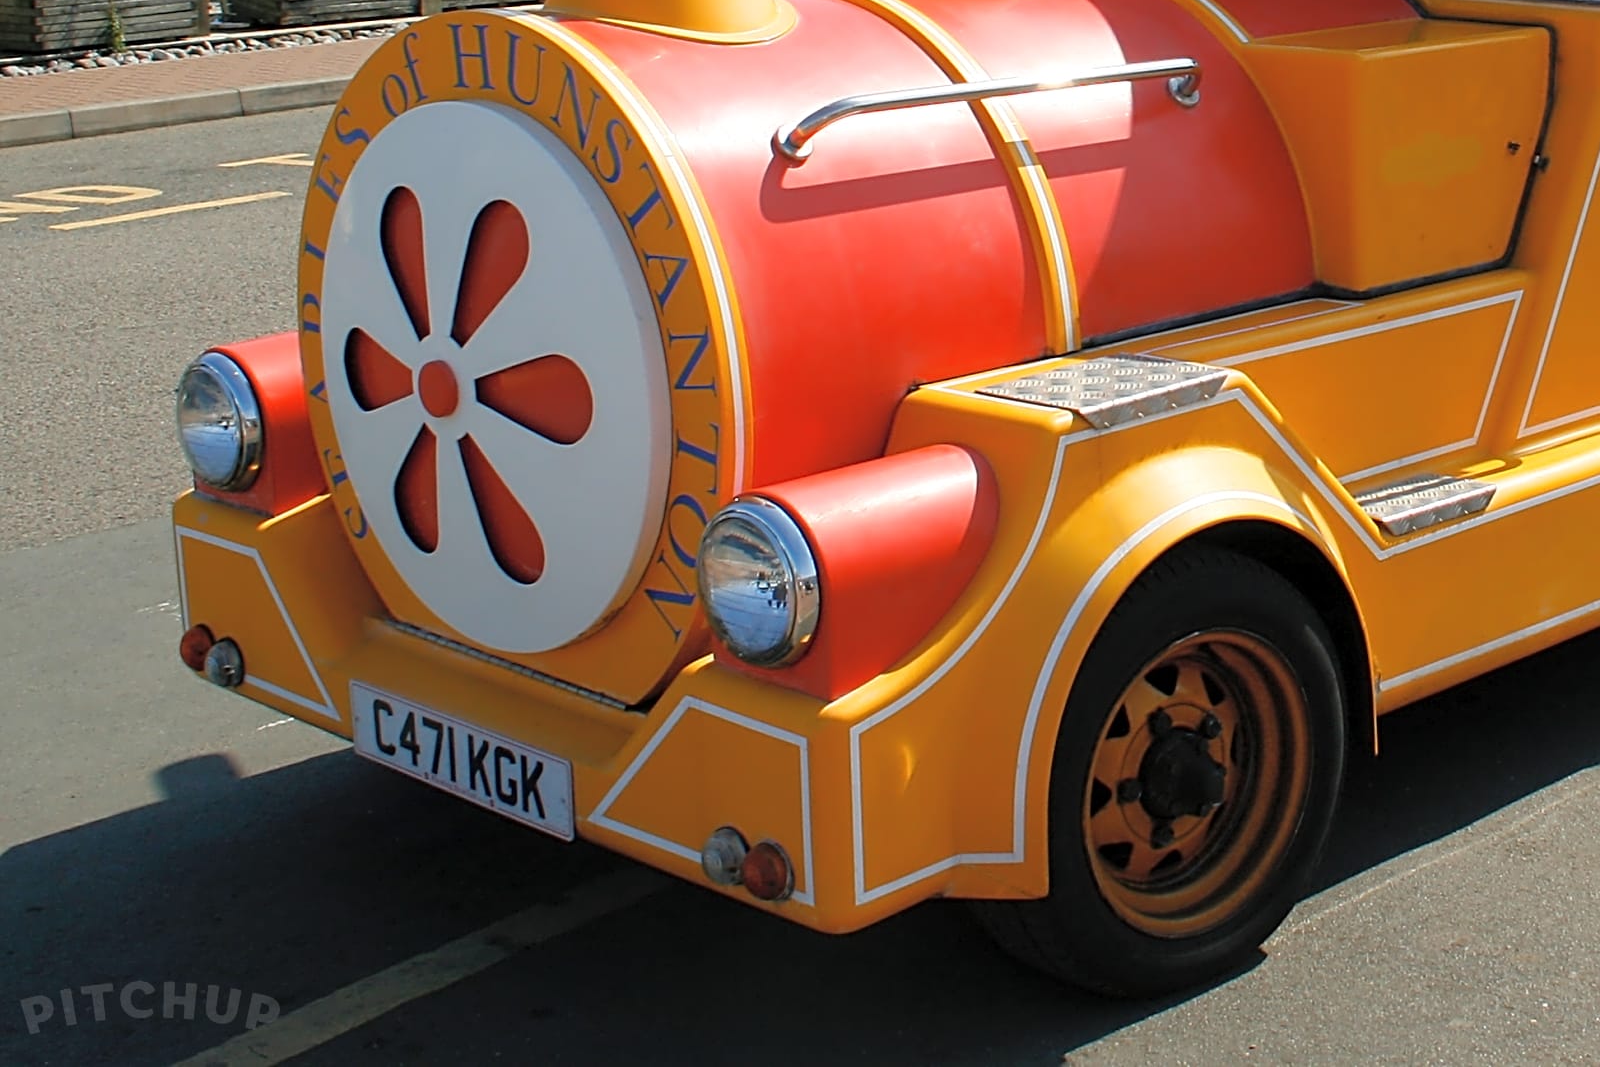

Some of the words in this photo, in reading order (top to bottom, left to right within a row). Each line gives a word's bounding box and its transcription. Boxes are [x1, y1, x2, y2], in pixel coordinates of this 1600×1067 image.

[382, 32, 429, 119] of
[447, 23, 720, 643] HUNSTANTON
[372, 698, 458, 783] C471
[467, 733, 546, 820] KGK
